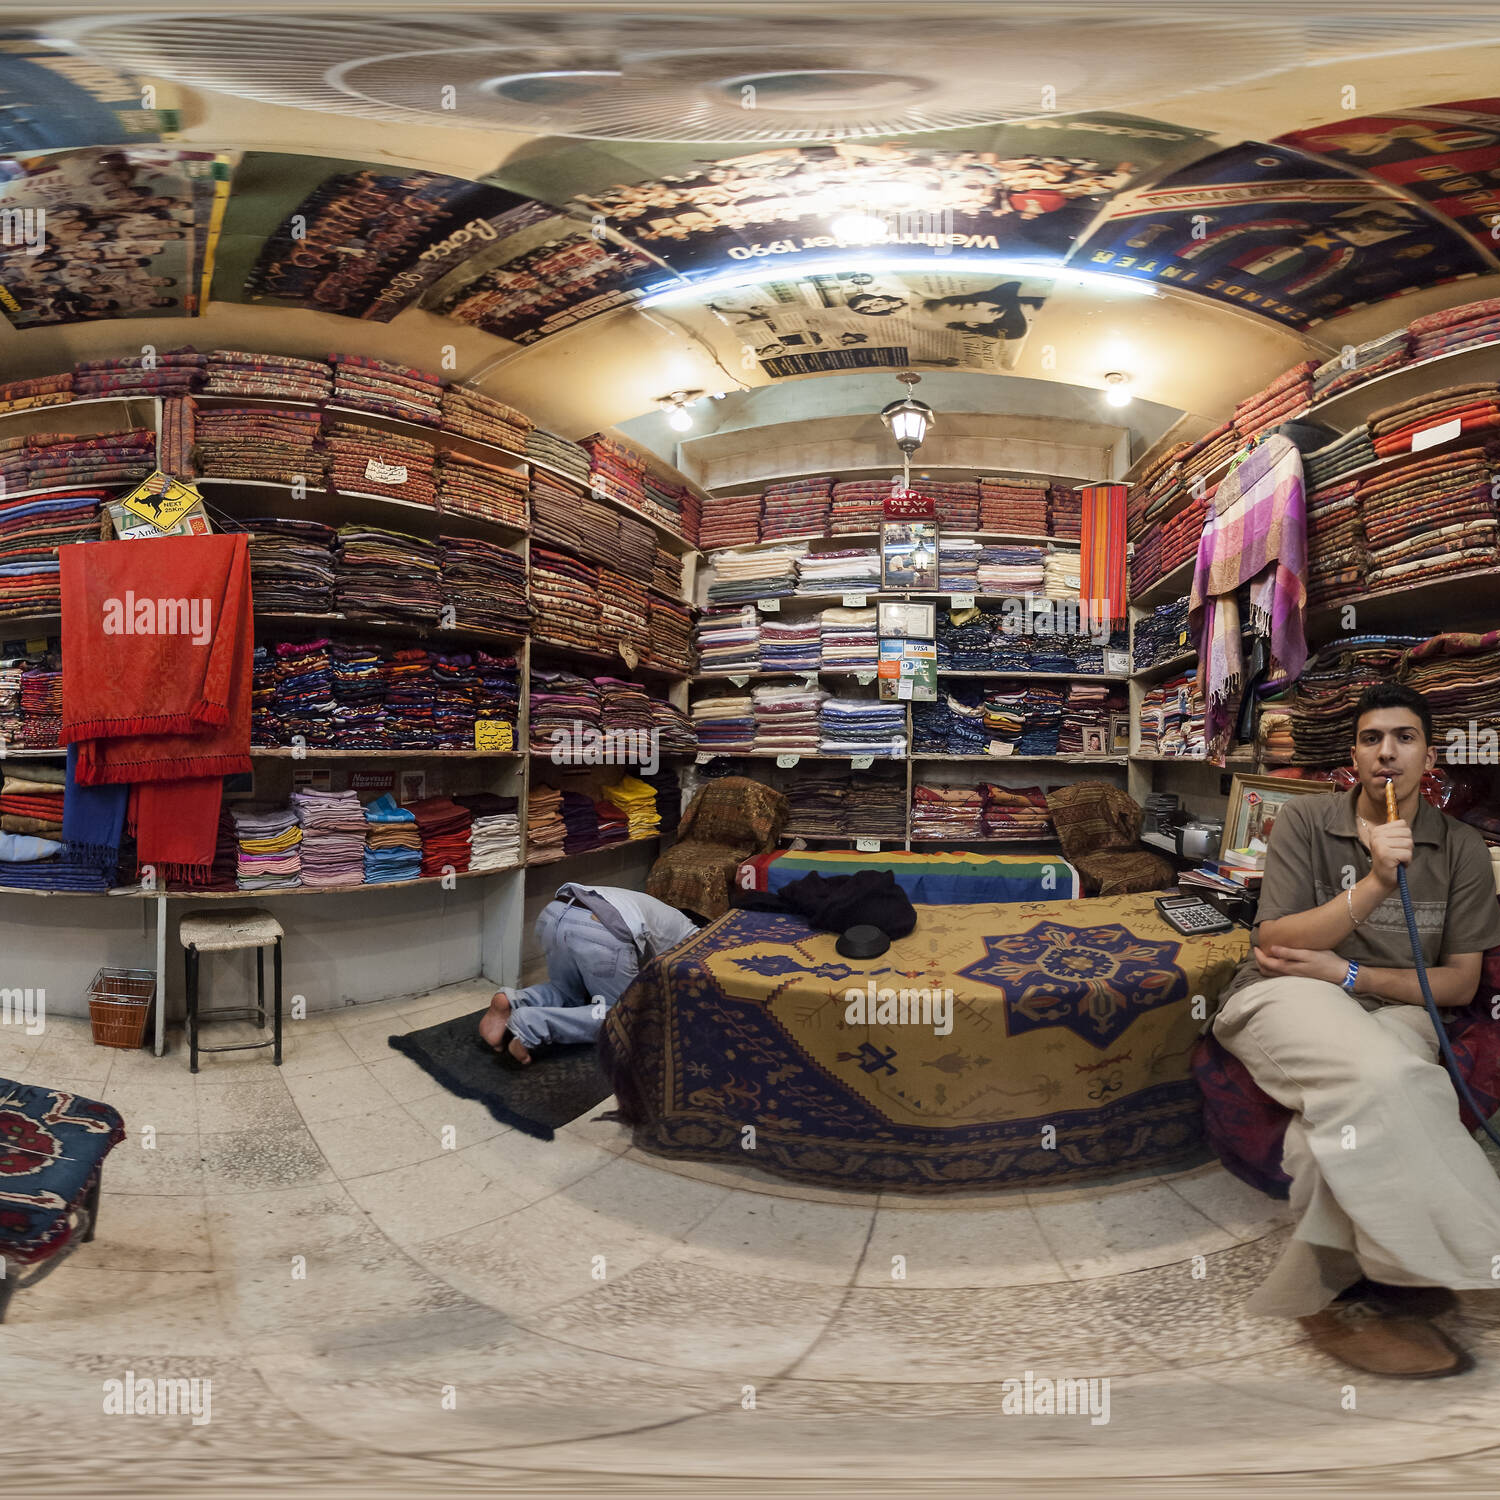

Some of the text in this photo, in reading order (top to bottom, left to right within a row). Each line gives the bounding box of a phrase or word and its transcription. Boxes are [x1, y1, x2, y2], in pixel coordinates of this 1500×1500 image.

[727, 238, 802, 260] 1990
[1089, 249, 1308, 321] GRANDE INTER
[889, 506, 928, 514] YEAR
